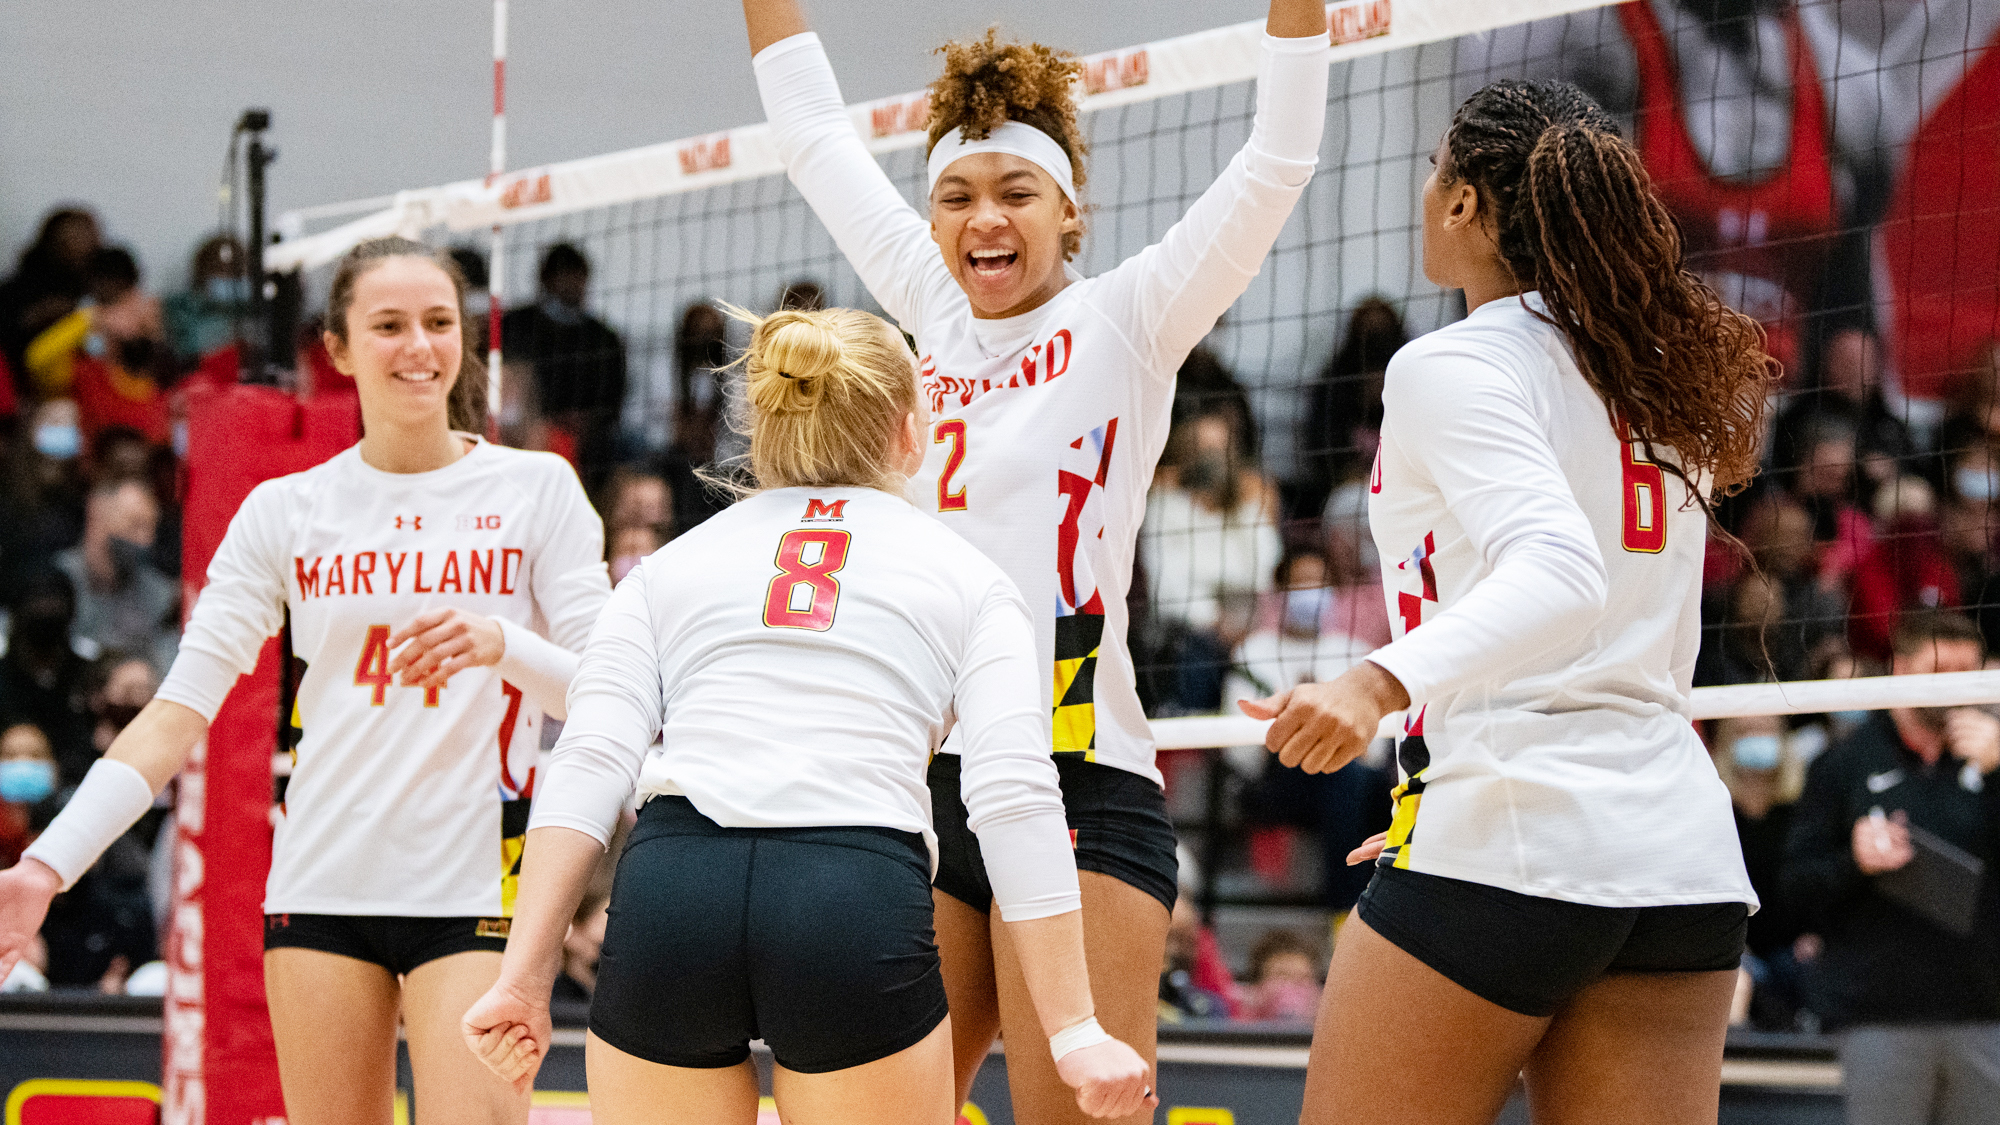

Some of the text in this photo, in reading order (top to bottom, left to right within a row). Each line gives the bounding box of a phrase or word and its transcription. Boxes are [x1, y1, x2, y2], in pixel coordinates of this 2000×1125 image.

[801, 498, 850, 519] M
[934, 418, 968, 512] 2
[1618, 414, 1667, 554] 6
[295, 548, 523, 600] MARYLAND
[762, 528, 852, 632] 8
